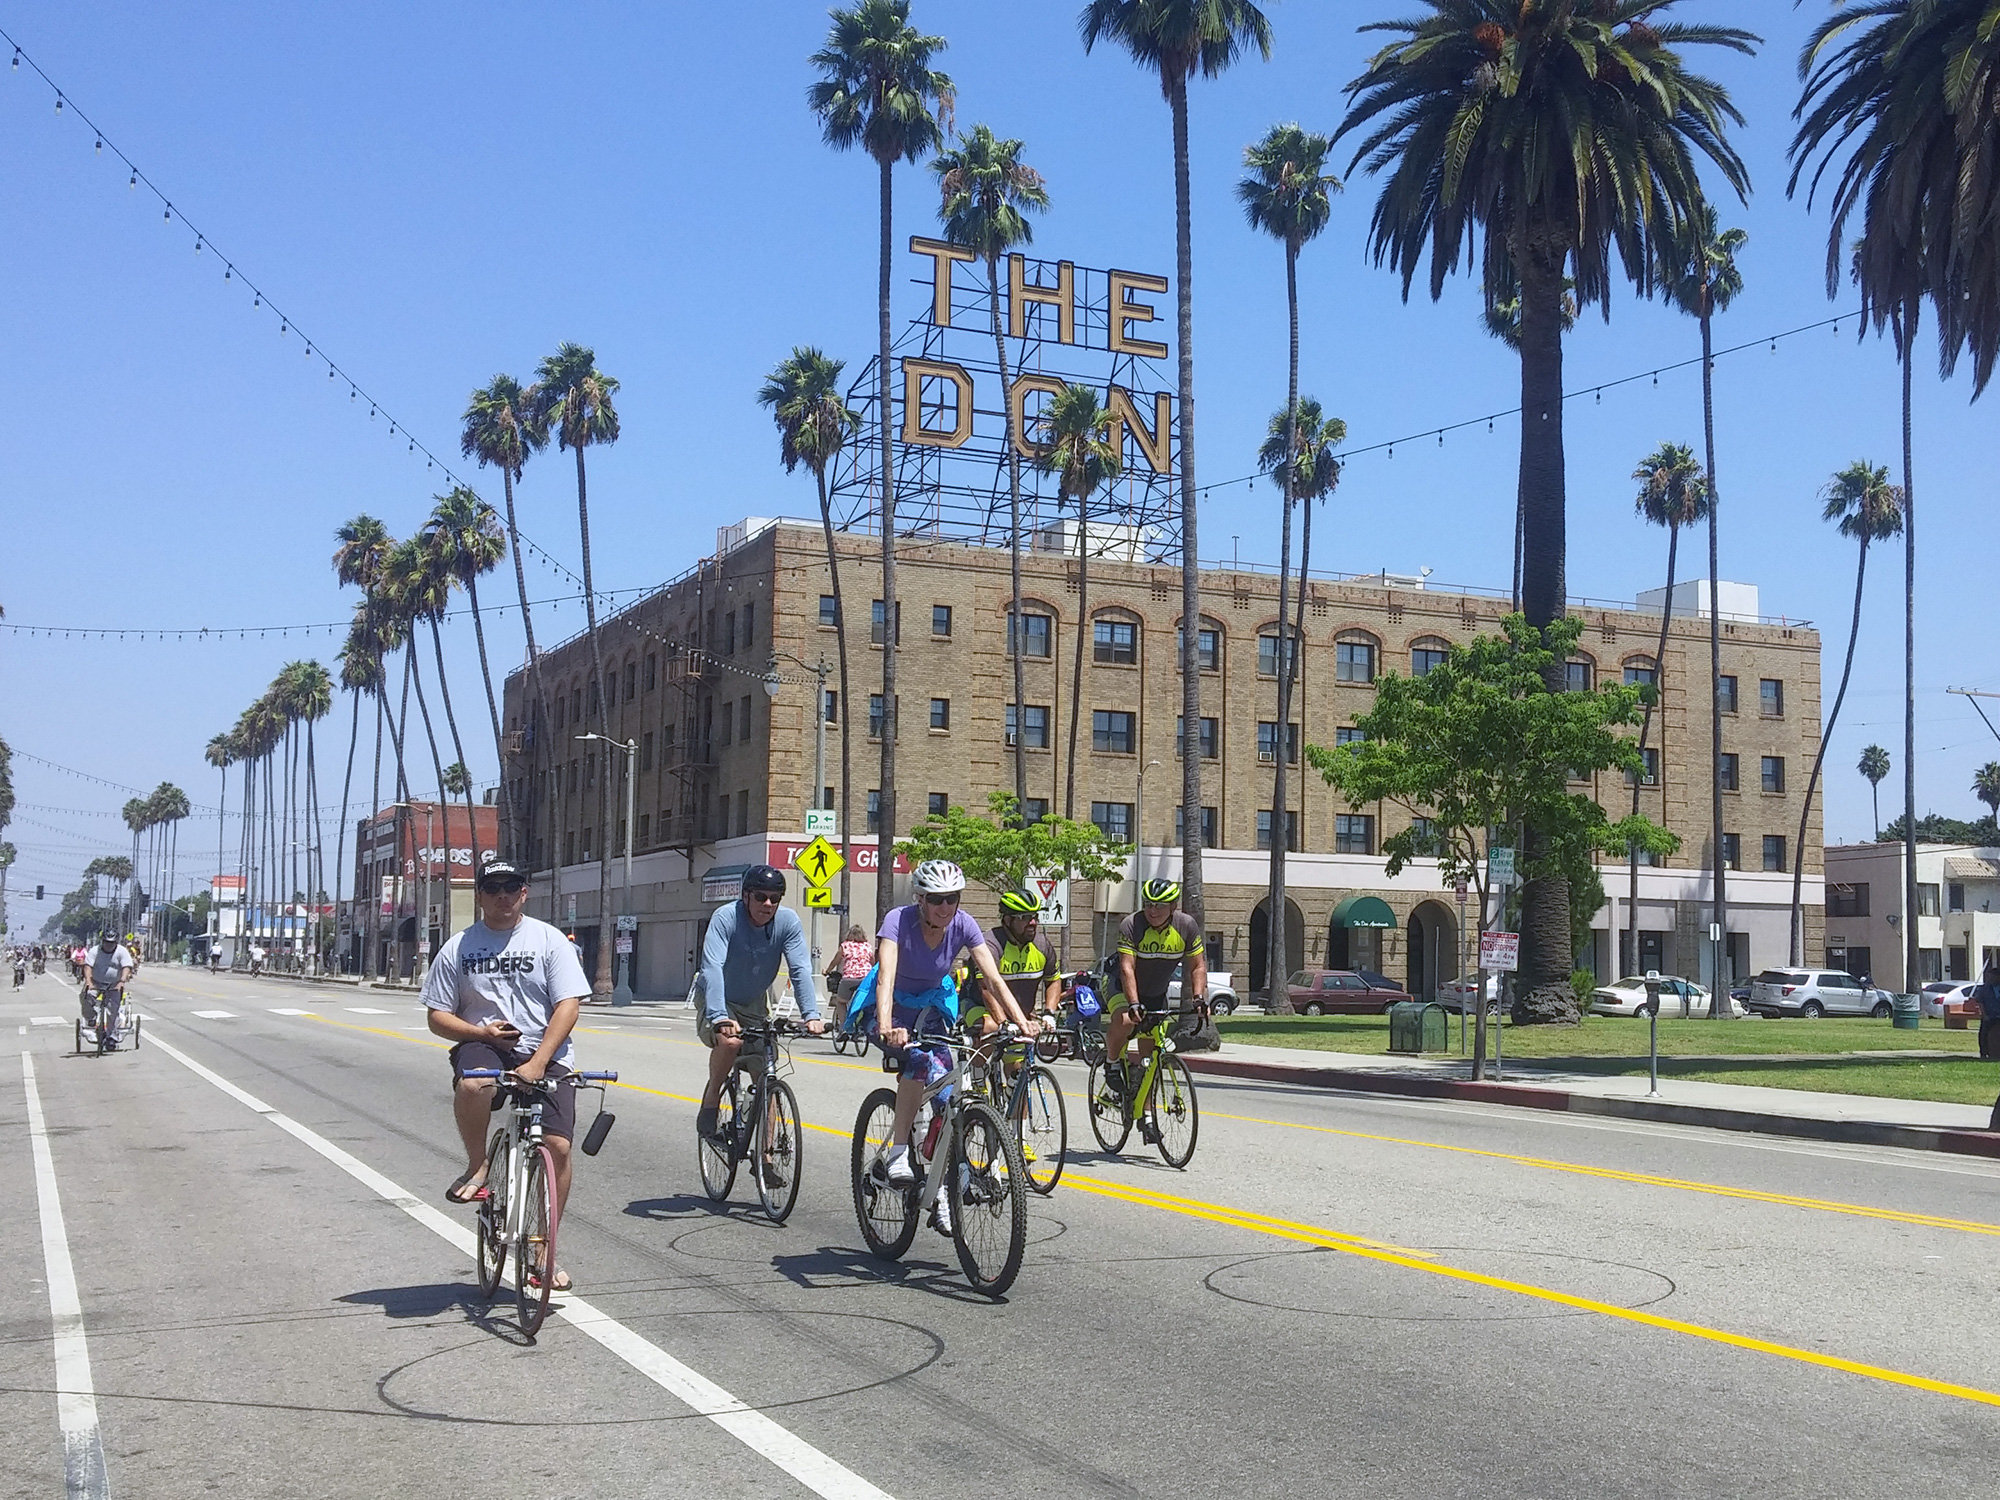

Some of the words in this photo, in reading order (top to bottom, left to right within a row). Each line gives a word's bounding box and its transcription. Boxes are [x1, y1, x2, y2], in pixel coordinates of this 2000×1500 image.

[910, 235, 1168, 359] THE
[902, 356, 1171, 474] DON
[1142, 941, 1179, 953] NOPAL
[1483, 941, 1494, 951] NO
[1494, 943, 1517, 952] STOPPING
[462, 951, 482, 959] LOS
[462, 956, 535, 976] RIDERS
[1003, 961, 1039, 974] NOPAL
[1080, 992, 1095, 1005] LA
